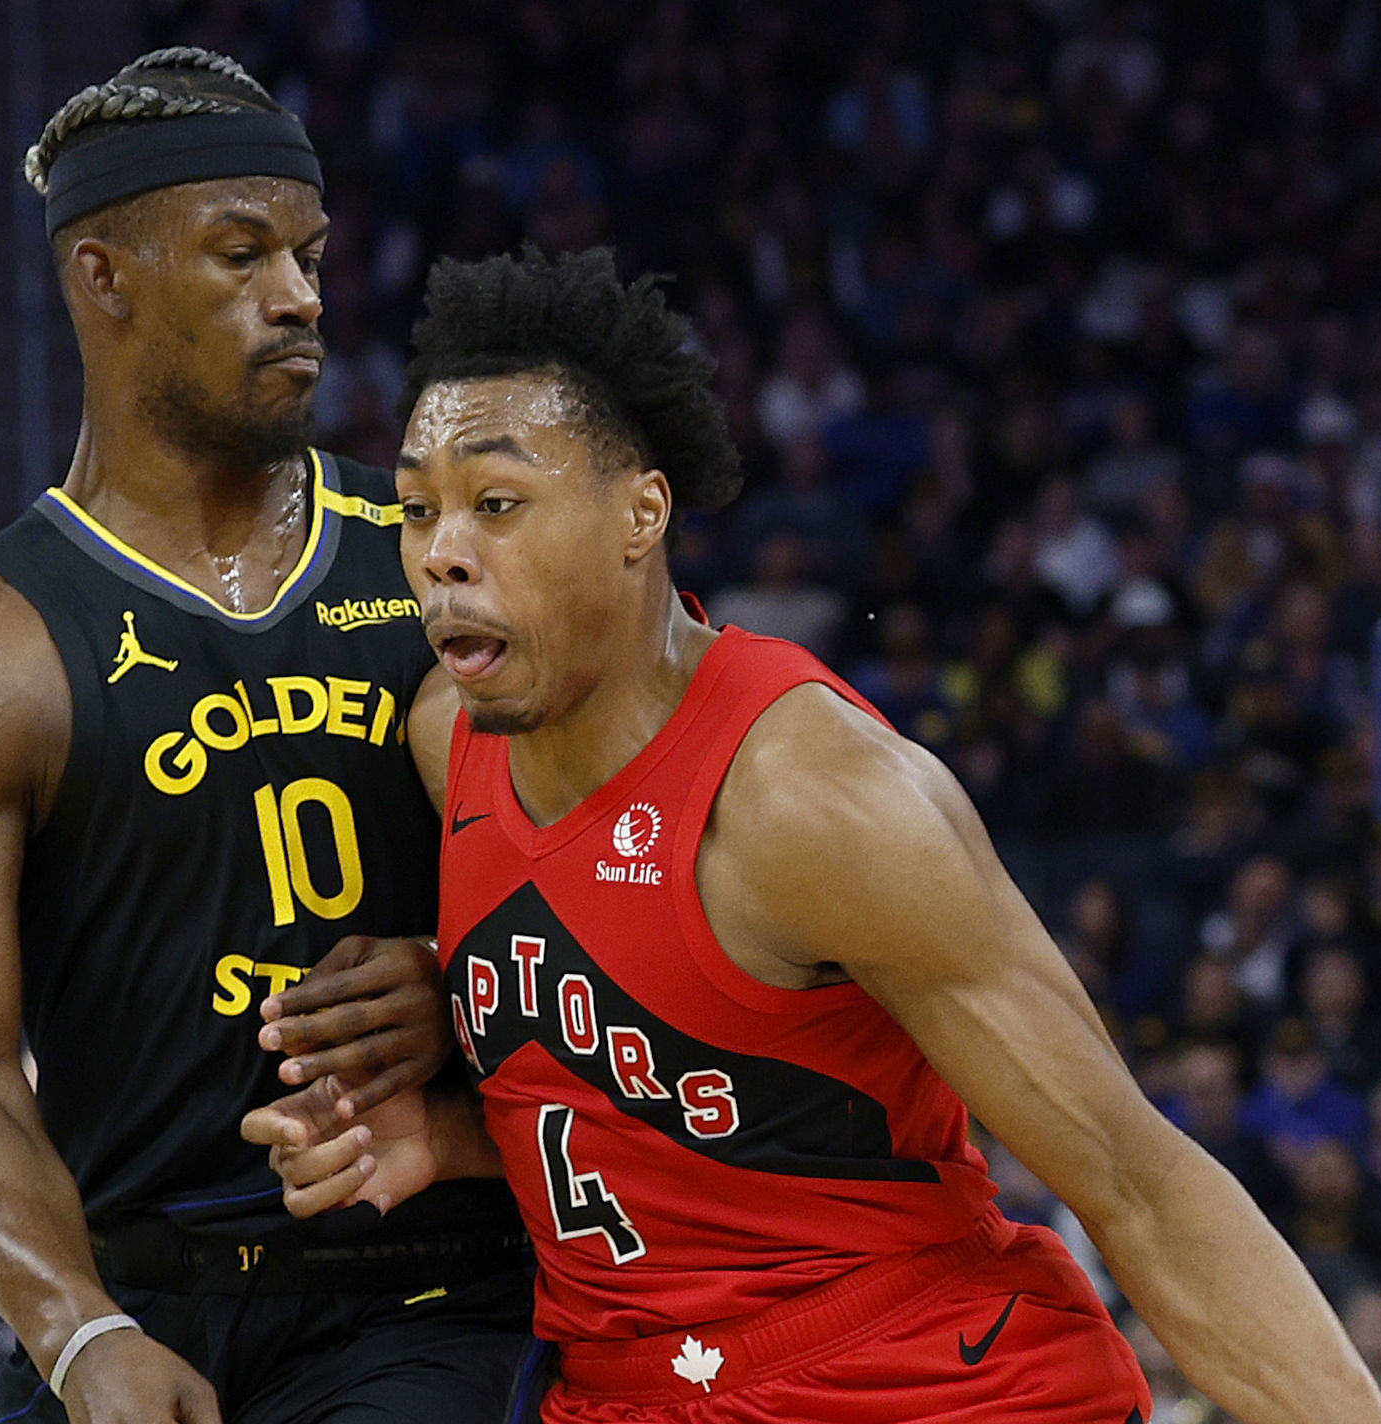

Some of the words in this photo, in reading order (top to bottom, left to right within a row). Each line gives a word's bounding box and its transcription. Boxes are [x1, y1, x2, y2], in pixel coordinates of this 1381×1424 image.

[315, 598, 421, 627] Rakuten
[253, 777, 363, 927] 10
[595, 860, 626, 882] Sun
[628, 862, 663, 885] Life
[452, 934, 740, 1140] APTORS
[537, 1103, 647, 1265] 4
